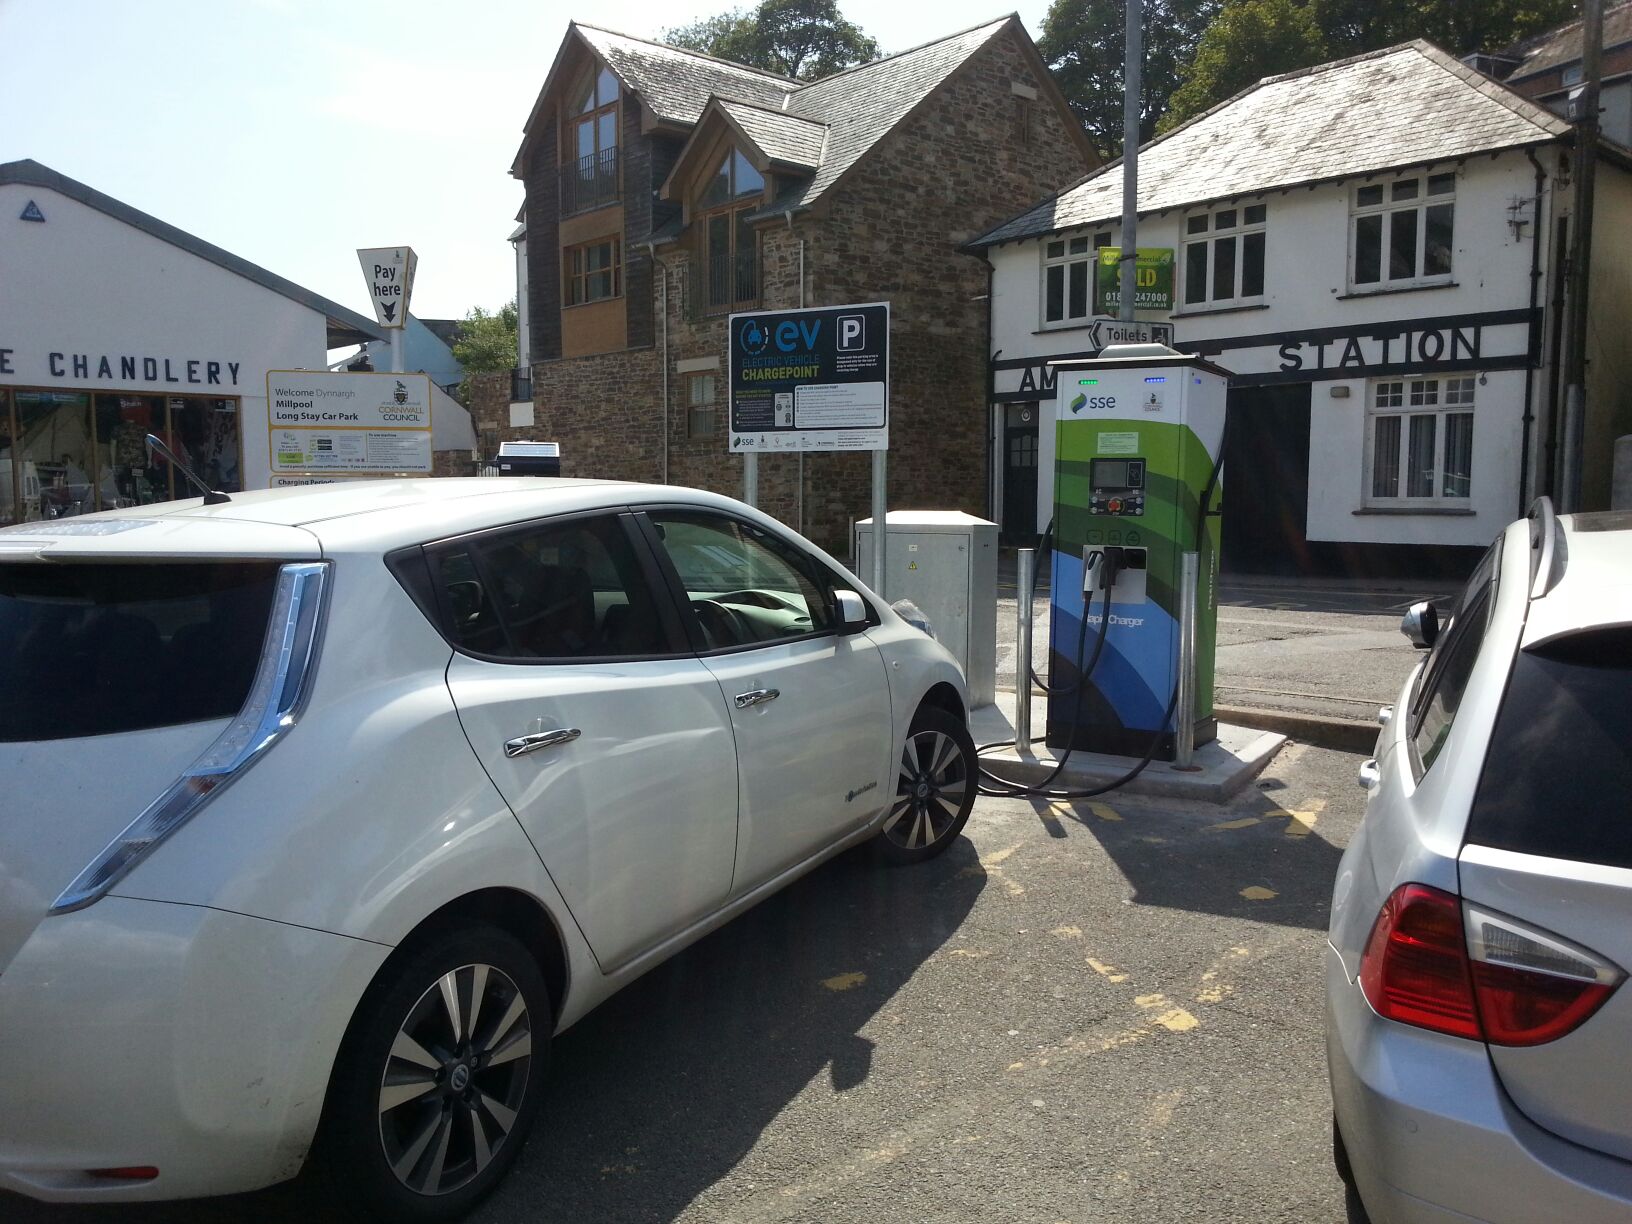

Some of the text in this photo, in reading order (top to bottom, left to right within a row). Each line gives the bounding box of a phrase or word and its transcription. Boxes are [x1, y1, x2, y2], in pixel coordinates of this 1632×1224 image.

[374, 265, 396, 282] Pay
[1116, 268, 1157, 287] SLD
[373, 282, 401, 297] here
[1135, 293, 1167, 302] 247000
[775, 319, 861, 352] ev P
[1106, 327, 1148, 342] Toilets
[1278, 325, 1482, 373] STATION
[742, 353, 820, 368] ELECTRIC VEHICLE
[49, 352, 240, 386] CHANDLERY
[742, 365, 820, 381] CHARGEPOINT
[275, 388, 356, 398] Welcome Dynnargh
[276, 400, 313, 409] Millpool
[1089, 396, 1116, 409] sse
[378, 406, 425, 414] CORNWALL
[276, 412, 359, 422] Long Stay Car Park
[383, 414, 421, 422] COUNCIL
[741, 438, 754, 446] sse
[278, 479, 309, 487] Charging
[1108, 615, 1144, 628] Charger
